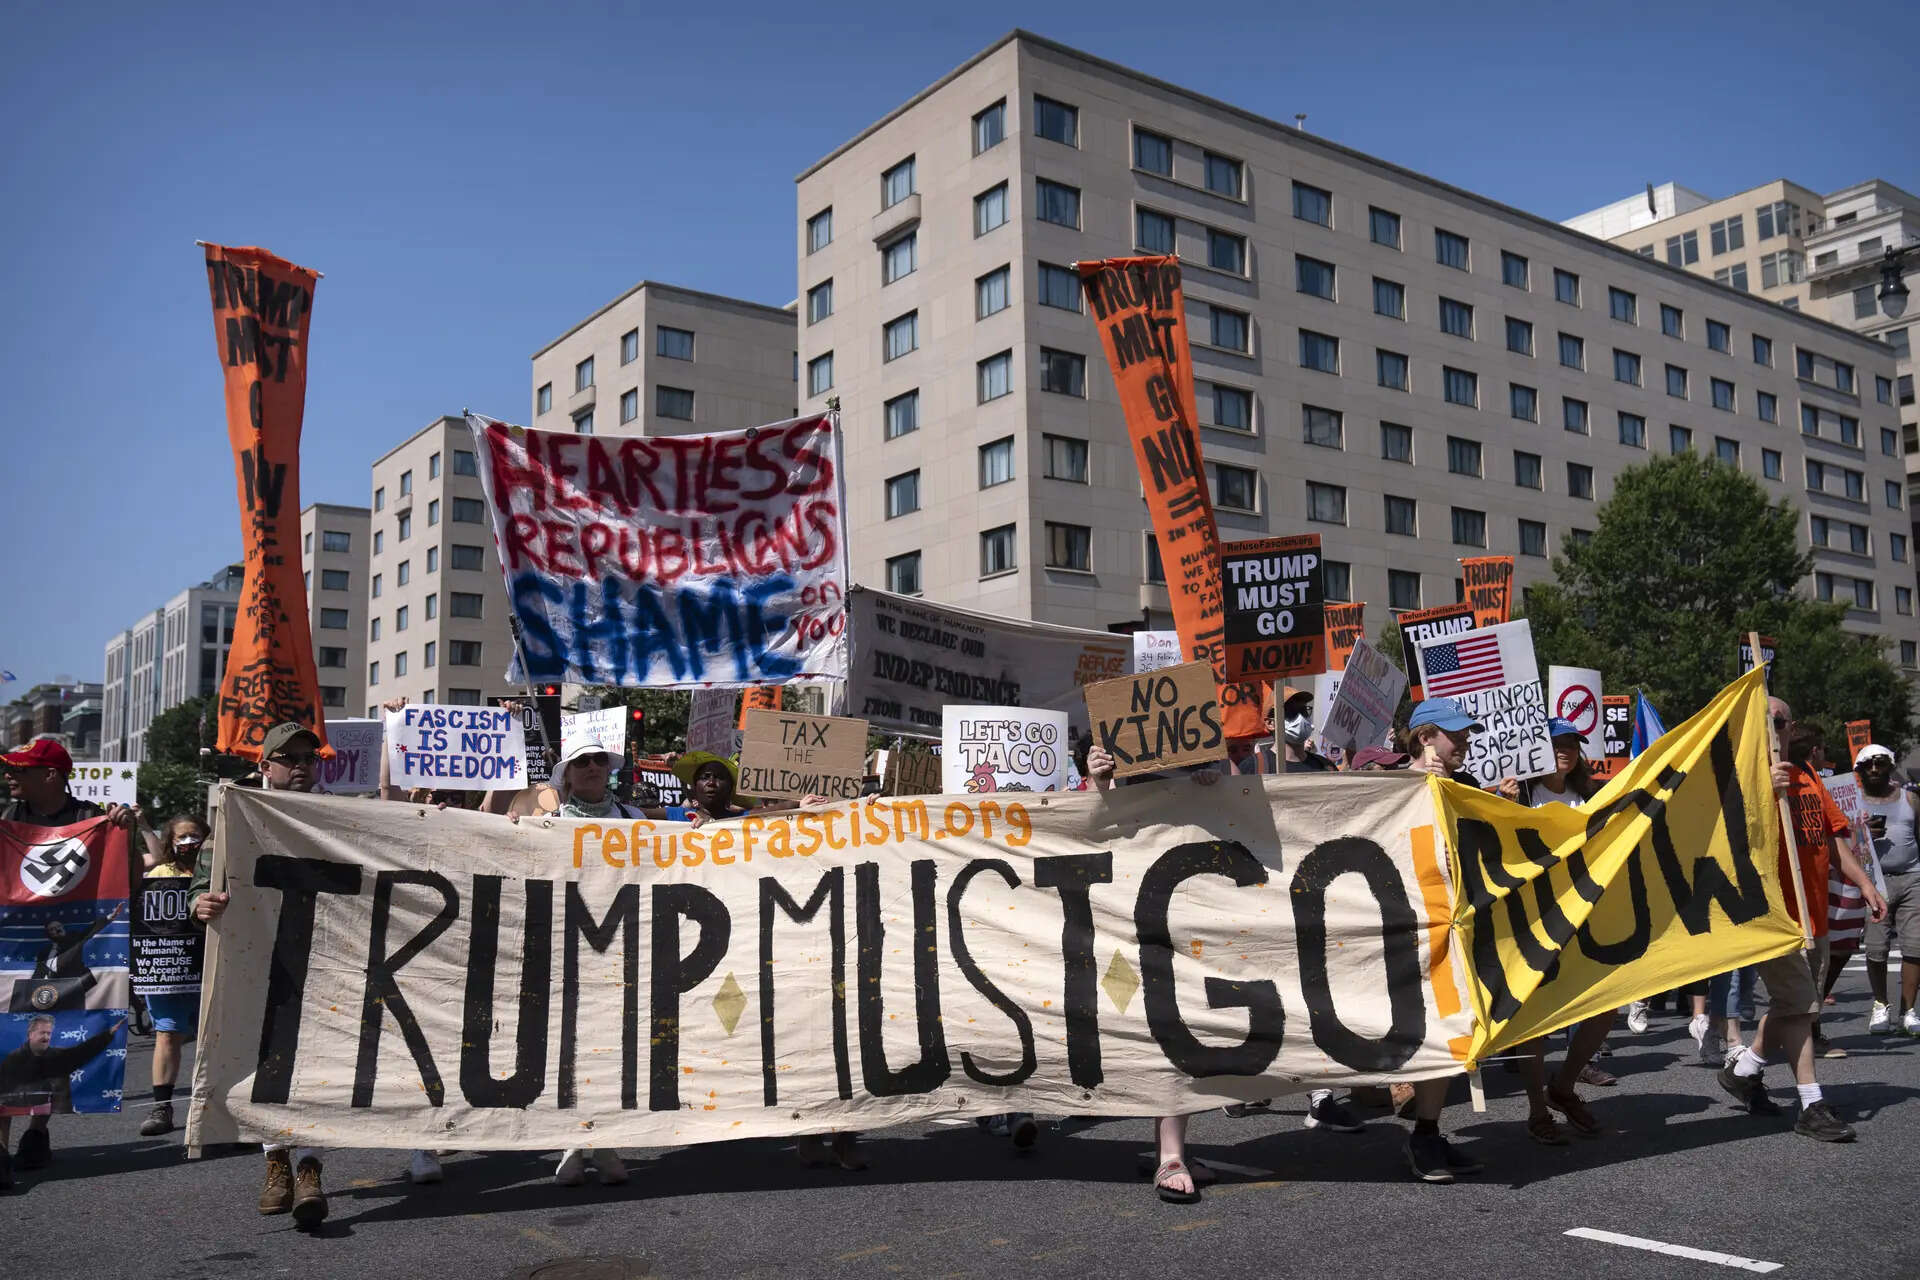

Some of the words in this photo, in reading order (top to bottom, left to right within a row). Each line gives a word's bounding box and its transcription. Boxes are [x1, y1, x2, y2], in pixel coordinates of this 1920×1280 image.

[485, 417, 834, 517] HEARTLESS
[505, 499, 837, 586] REPUBLICANS
[1226, 554, 1318, 584] TRUMP
[1238, 581, 1311, 610] MUST
[513, 571, 804, 686] SHAME
[876, 613, 896, 635] WE
[900, 621, 959, 650] DECLARE
[961, 637, 985, 658] OUR
[1256, 610, 1295, 636] GO
[1404, 617, 1474, 643] TRUMP
[1241, 642, 1314, 673] NOW!
[873, 650, 1021, 706] INDEPENDENCE
[863, 698, 903, 720] FROM
[1130, 676, 1178, 713] NO
[1482, 680, 1542, 712] TINPOT
[405, 708, 511, 732] FASCISM
[960, 720, 1022, 742] LET'S
[1025, 722, 1058, 745] GO
[1481, 704, 1548, 732] TATORS
[418, 729, 449, 751] IS
[461, 732, 506, 755] NOT
[779, 718, 830, 748] TAX
[1098, 701, 1223, 766] KINGS
[404, 753, 515, 780] FREEDOM
[783, 746, 816, 765] THE
[959, 742, 1057, 777] TACO
[68, 767, 113, 780] STOP
[740, 767, 862, 799] BILLIONAIRES
[74, 785, 112, 796] THE
[573, 799, 1034, 869] refusefascism.org
[144, 890, 187, 921] NO!
[133, 939, 141, 947] In
[142, 938, 157, 947] the
[159, 938, 185, 947] Name
[186, 937, 196, 946] of
[141, 946, 186, 957] Humanity,
[136, 958, 151, 967] We
[153, 956, 193, 966] REFUSE
[138, 967, 148, 975] to
[149, 967, 180, 976] Accept
[250, 854, 732, 1111] TRUMP
[758, 849, 1113, 1108] MUST
